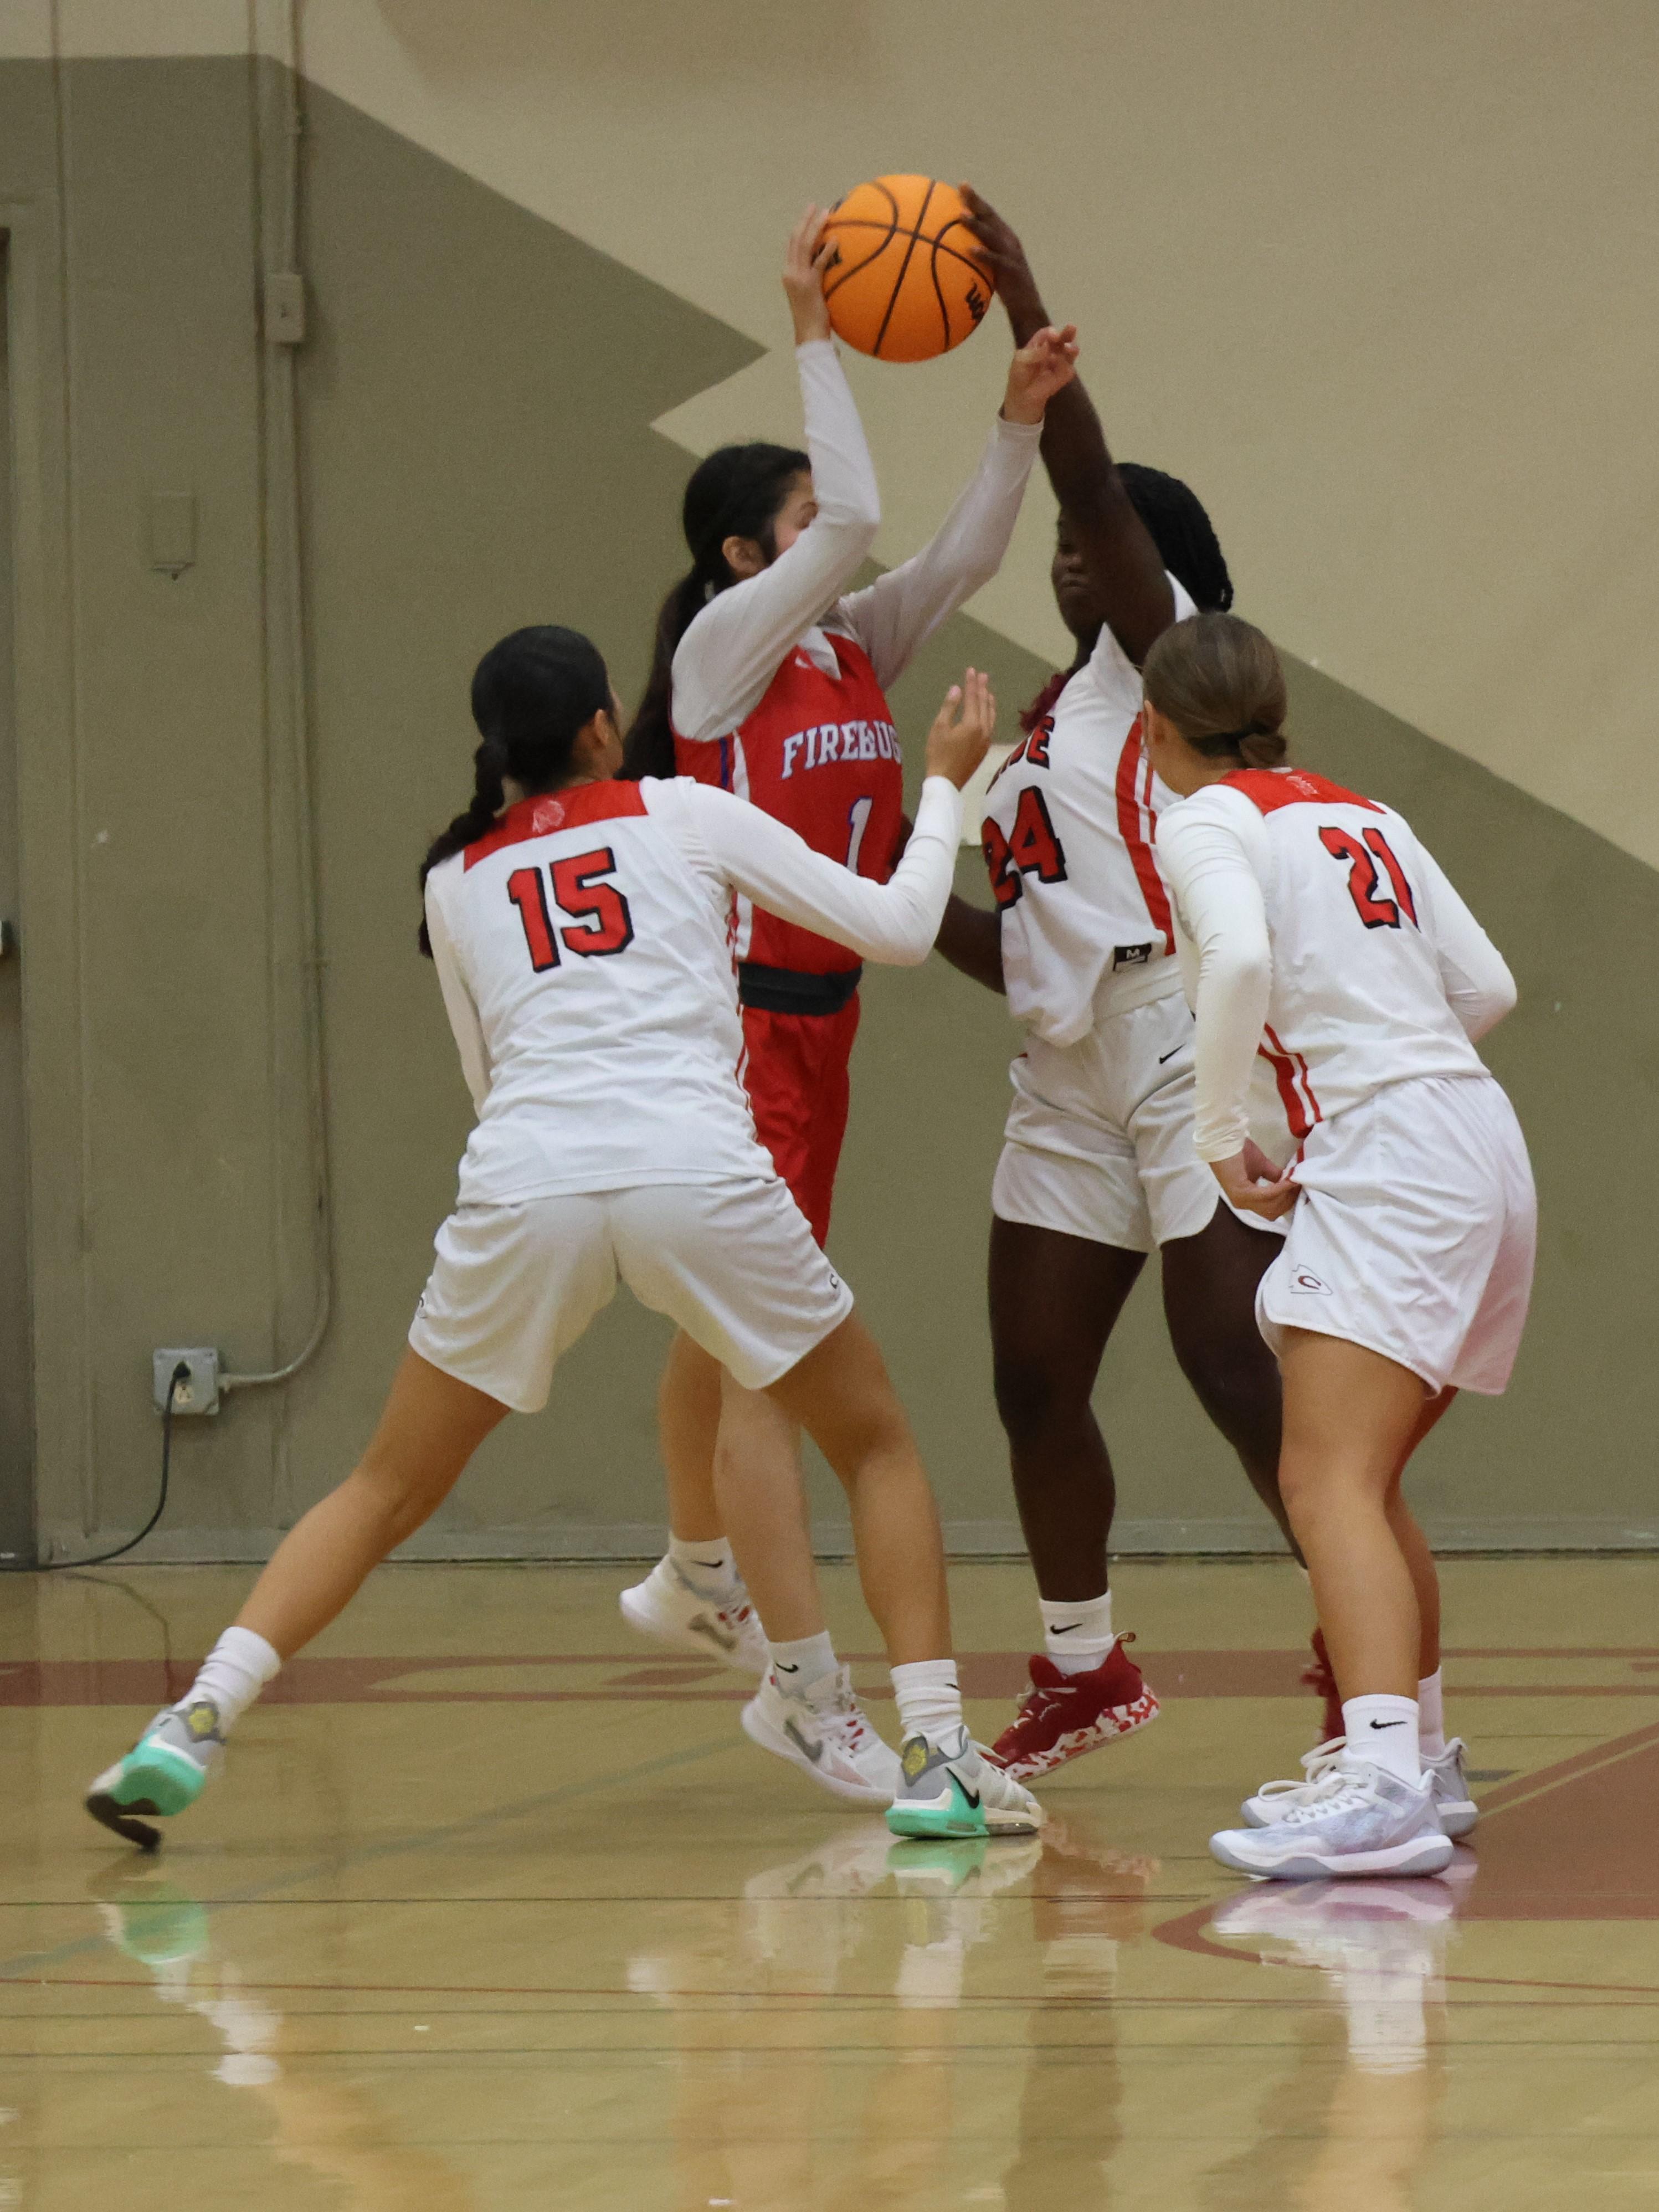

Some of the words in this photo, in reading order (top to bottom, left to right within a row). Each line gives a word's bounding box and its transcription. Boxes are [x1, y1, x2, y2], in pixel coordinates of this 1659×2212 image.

[507, 846, 635, 973] 15
[981, 786, 1067, 910] 24
[1318, 825, 1421, 933] 21
